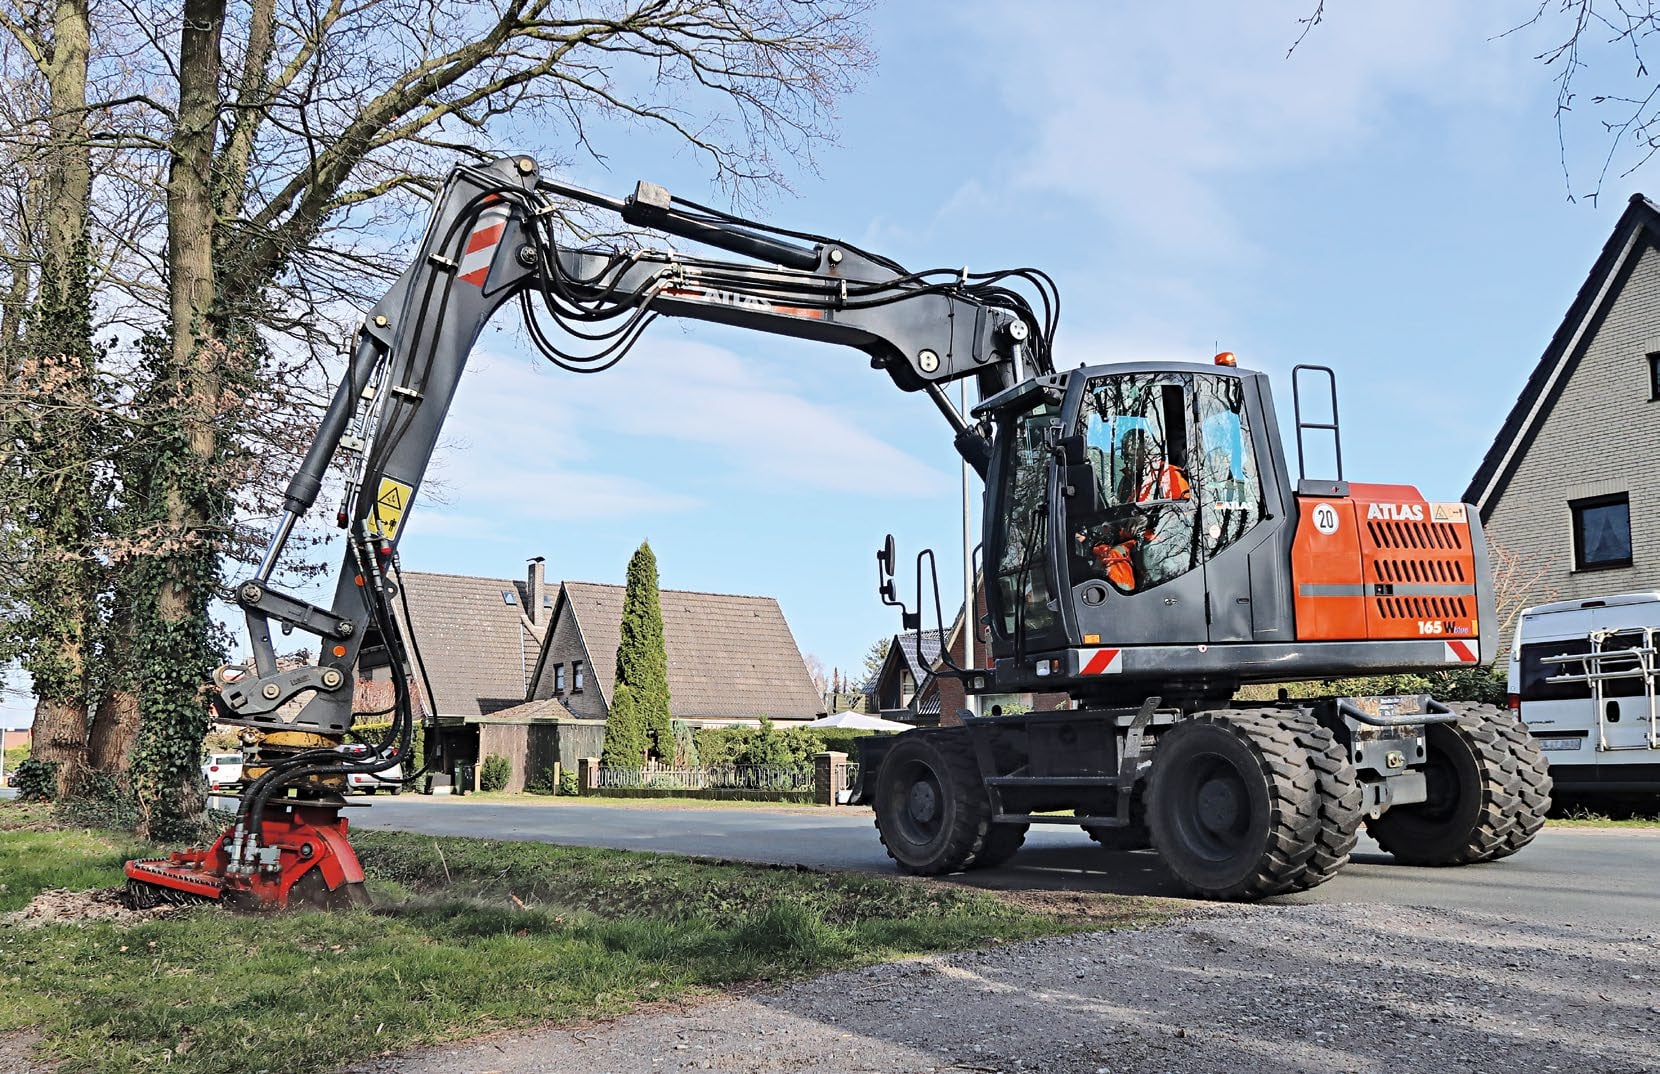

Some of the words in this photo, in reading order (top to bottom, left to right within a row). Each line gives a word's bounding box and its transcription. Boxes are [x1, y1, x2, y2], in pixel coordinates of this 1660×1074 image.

[1222, 501, 1254, 511] ATLAS
[1367, 503, 1424, 521] ATLAS
[1318, 510, 1334, 529] 20
[1418, 620, 1442, 634] 165
